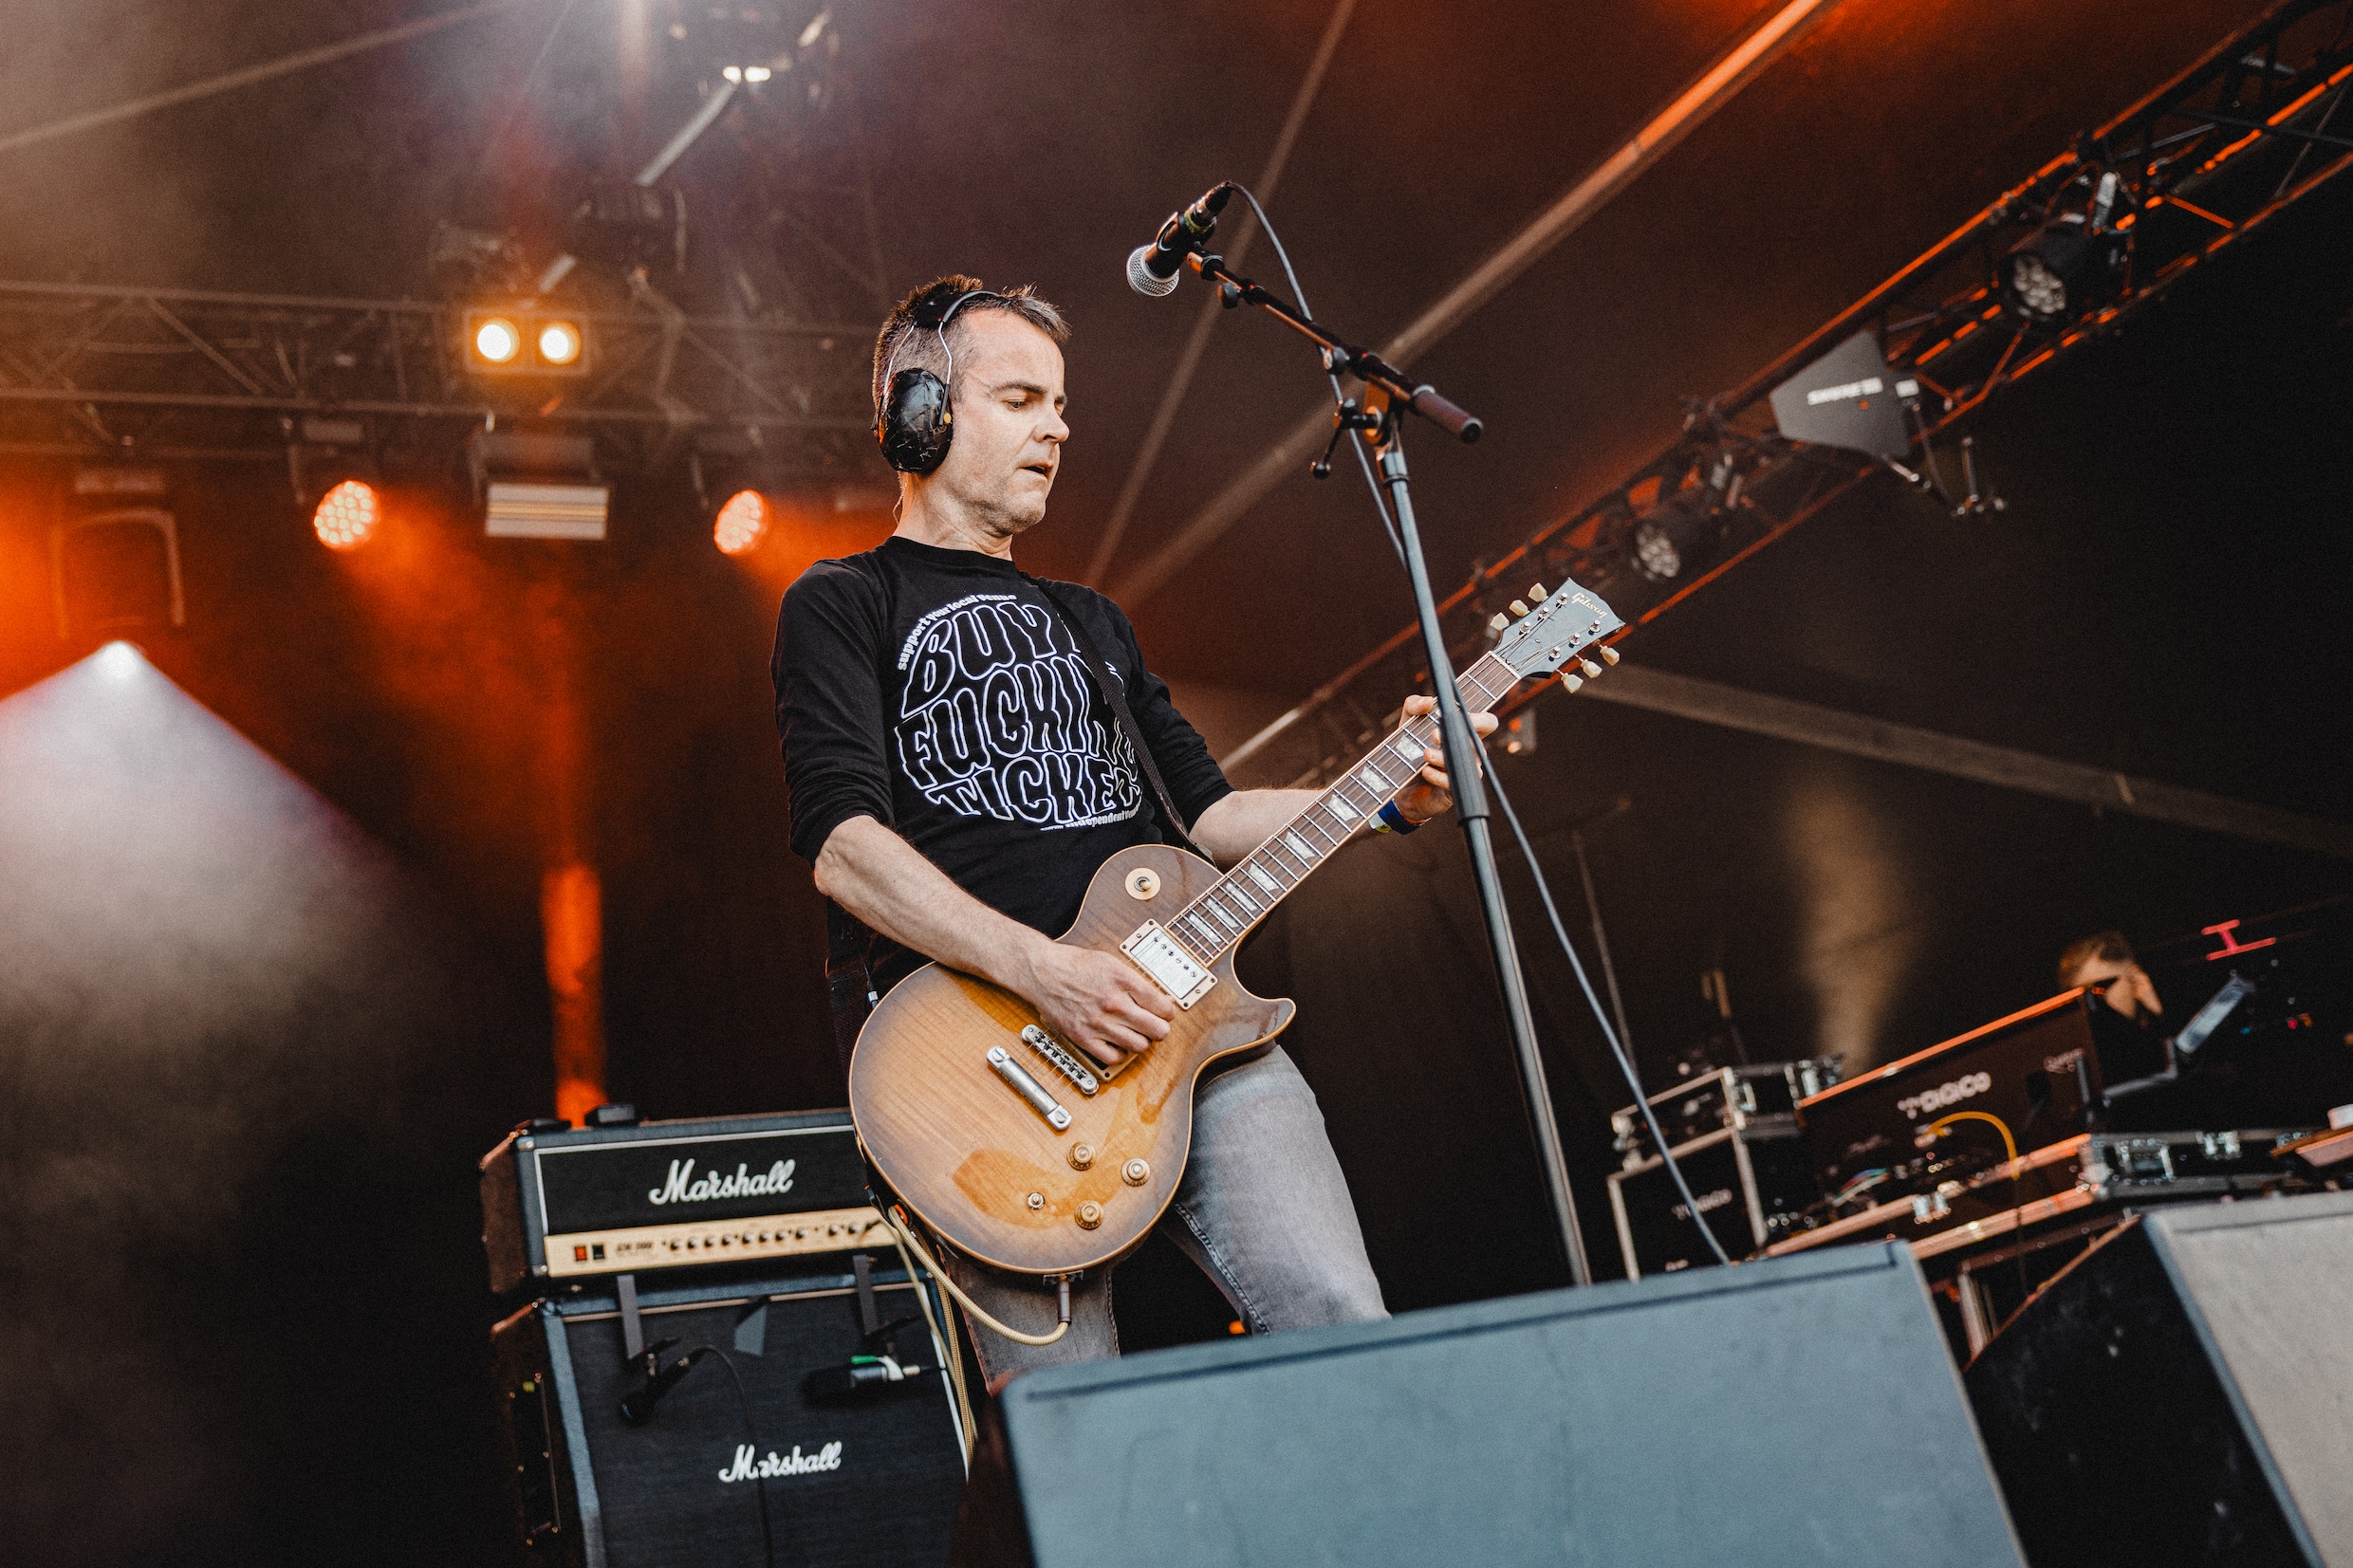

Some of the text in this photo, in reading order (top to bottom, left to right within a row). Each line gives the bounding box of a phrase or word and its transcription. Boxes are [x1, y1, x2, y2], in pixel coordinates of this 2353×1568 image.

[898, 617, 932, 671] support
[925, 606, 952, 621] your
[946, 594, 979, 612] local
[1571, 592, 1608, 620] Gibson
[901, 600, 1057, 719] BUY
[648, 1157, 796, 1206] Marshall
